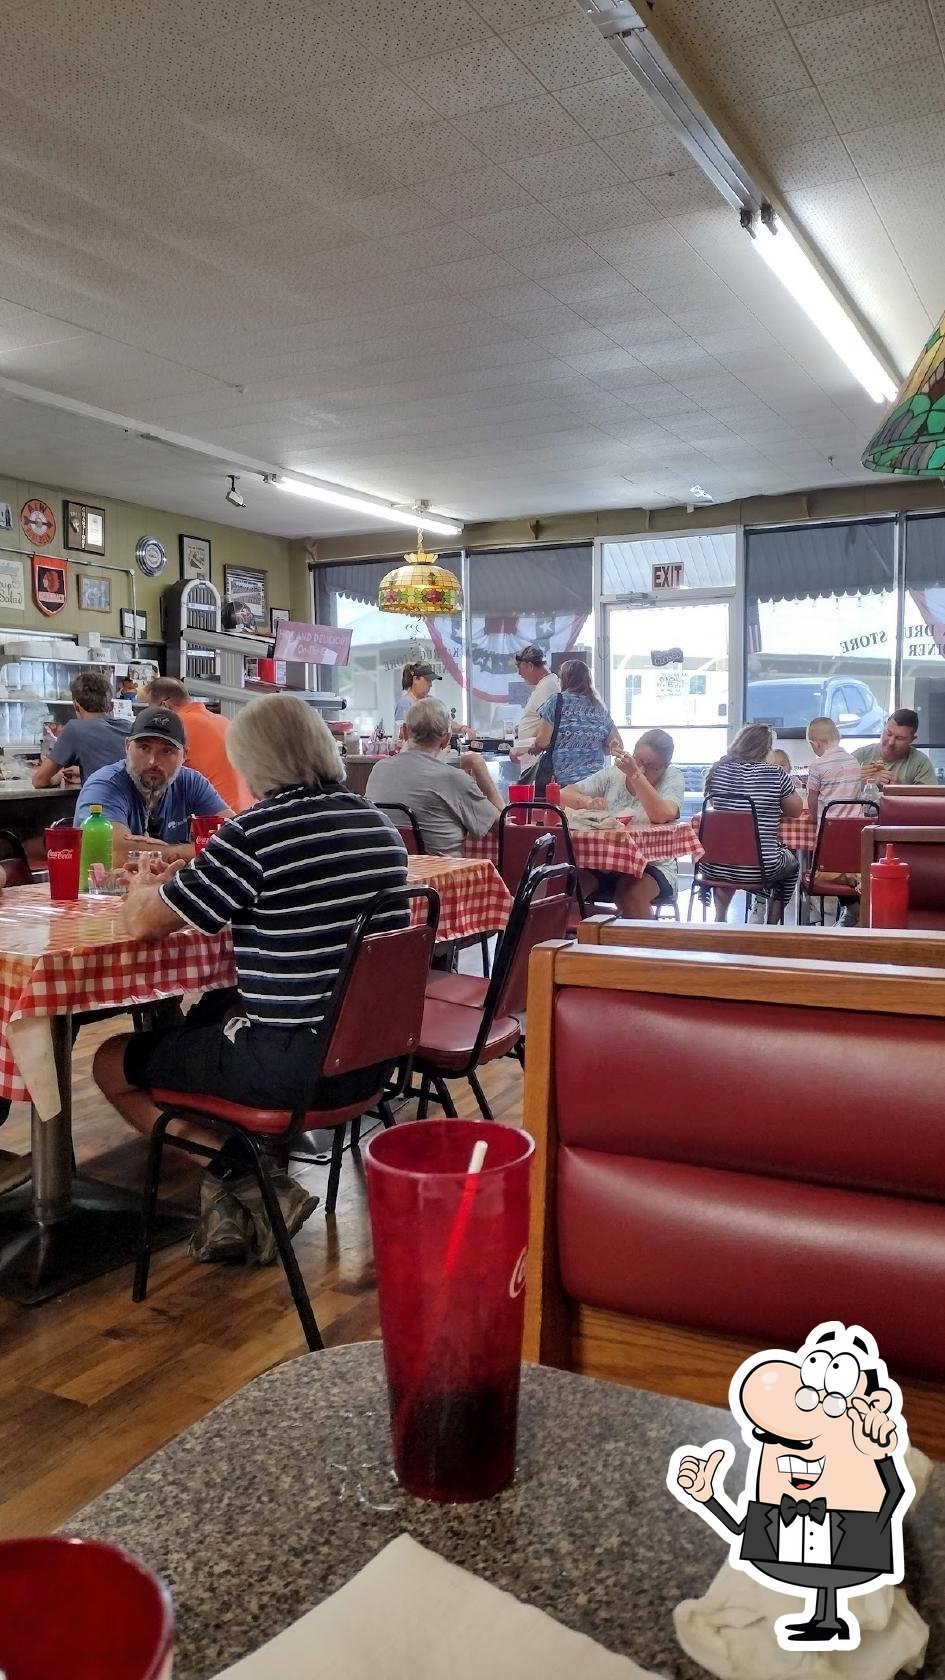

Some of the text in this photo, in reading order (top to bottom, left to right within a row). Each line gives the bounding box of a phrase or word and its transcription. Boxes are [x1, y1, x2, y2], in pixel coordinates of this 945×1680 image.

[654, 565, 682, 587] EXIT
[297, 631, 312, 642] AND
[47, 848, 74, 860] Coca-Cola
